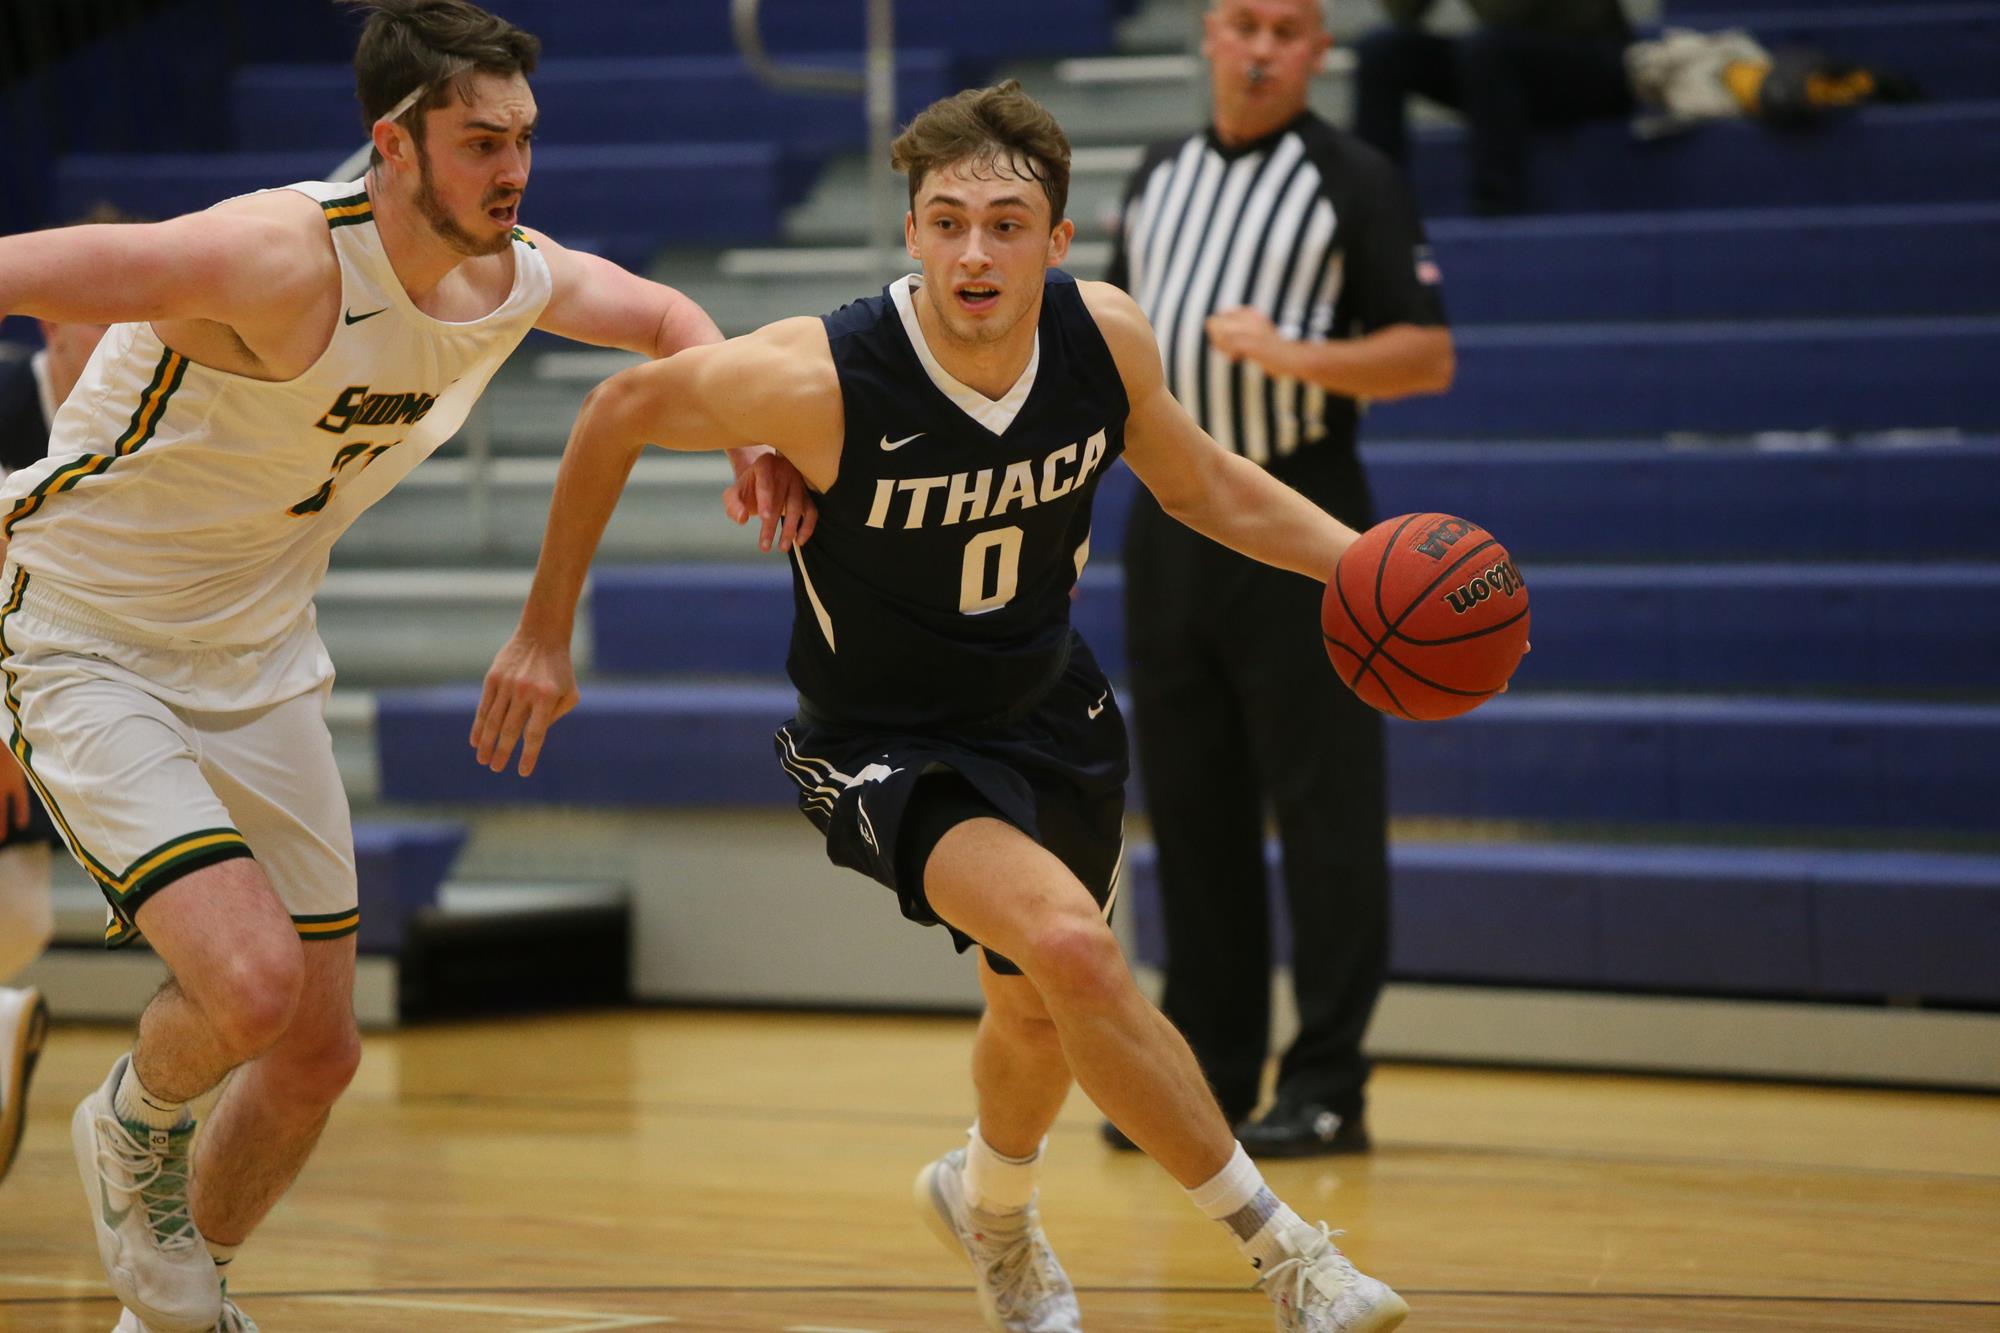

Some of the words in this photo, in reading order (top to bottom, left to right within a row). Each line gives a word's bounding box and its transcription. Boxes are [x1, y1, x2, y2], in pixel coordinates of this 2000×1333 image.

[864, 427, 1107, 529] ITHACA
[959, 525, 1024, 615] 0
[1415, 518, 1483, 561] CAA
